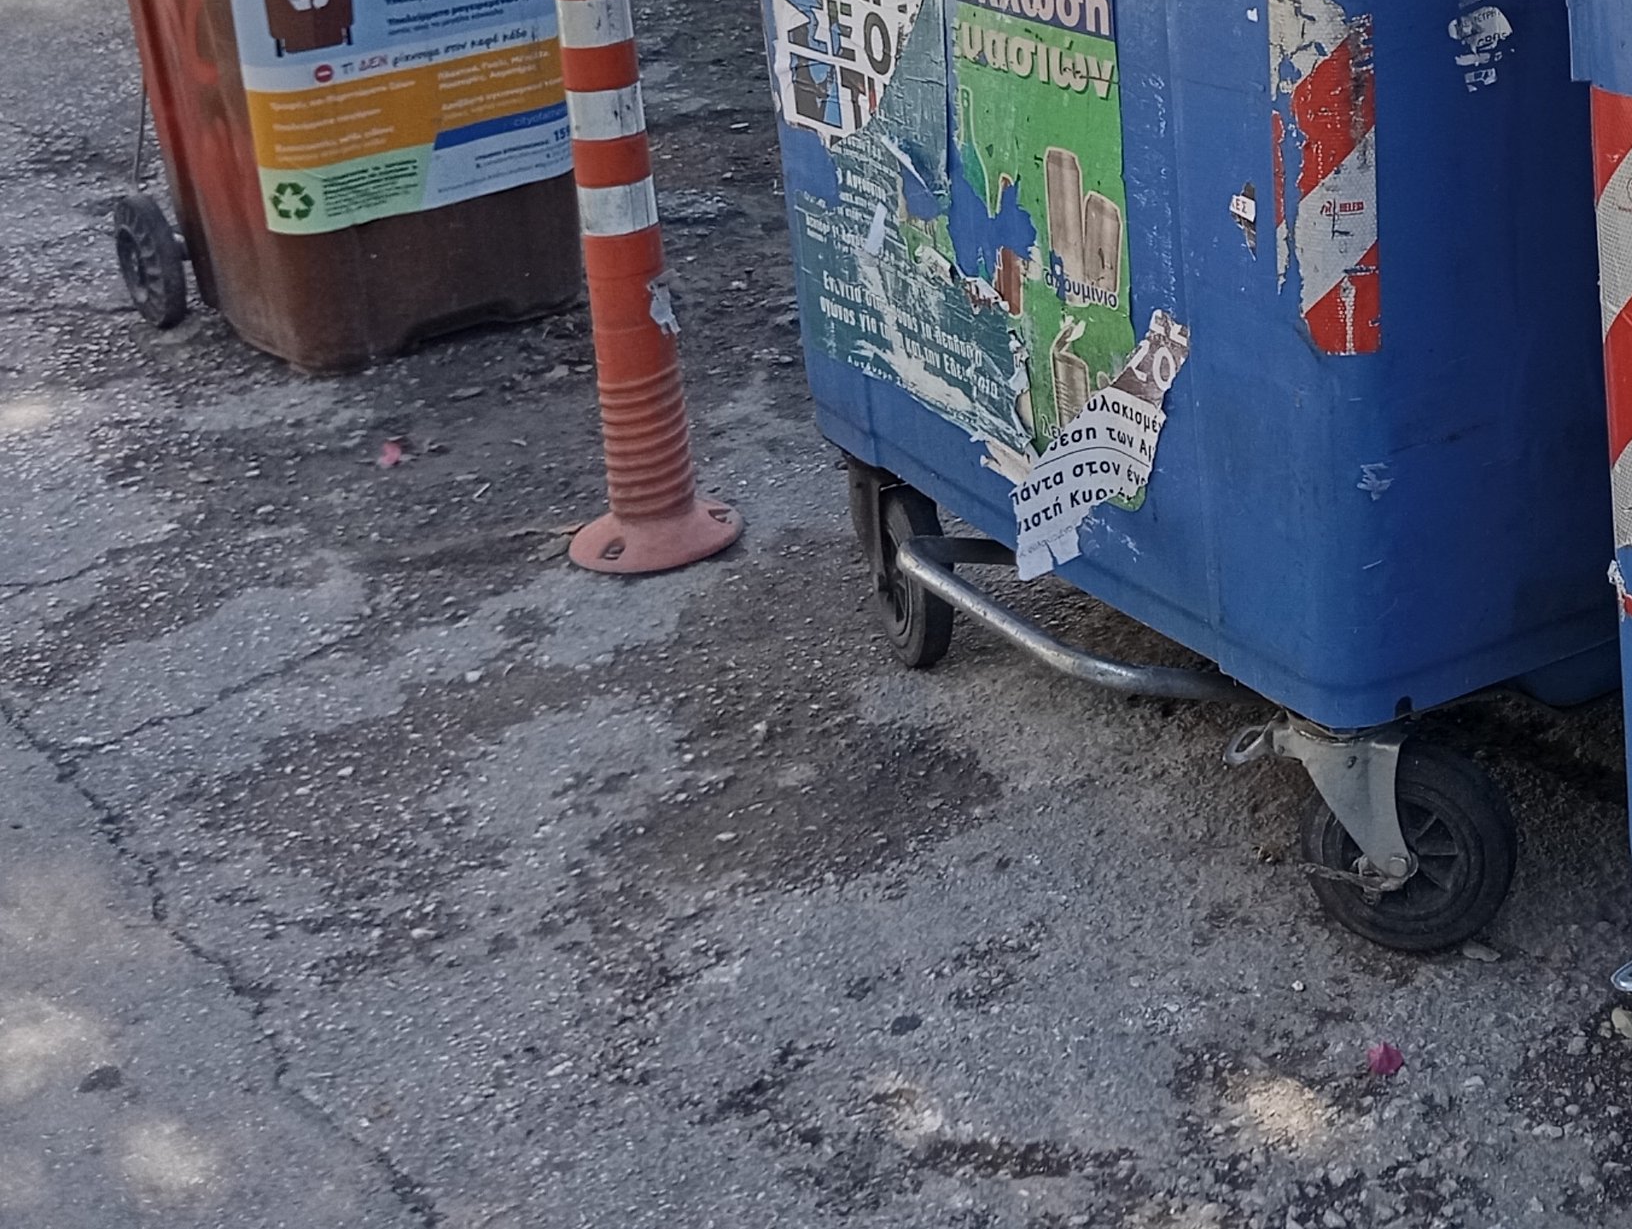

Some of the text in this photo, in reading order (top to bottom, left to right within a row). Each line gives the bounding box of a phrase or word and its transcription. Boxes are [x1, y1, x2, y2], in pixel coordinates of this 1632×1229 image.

[1076, 393, 1163, 435] υλακισμέ
[1106, 426, 1135, 448] των
[1073, 460, 1121, 478] στον
